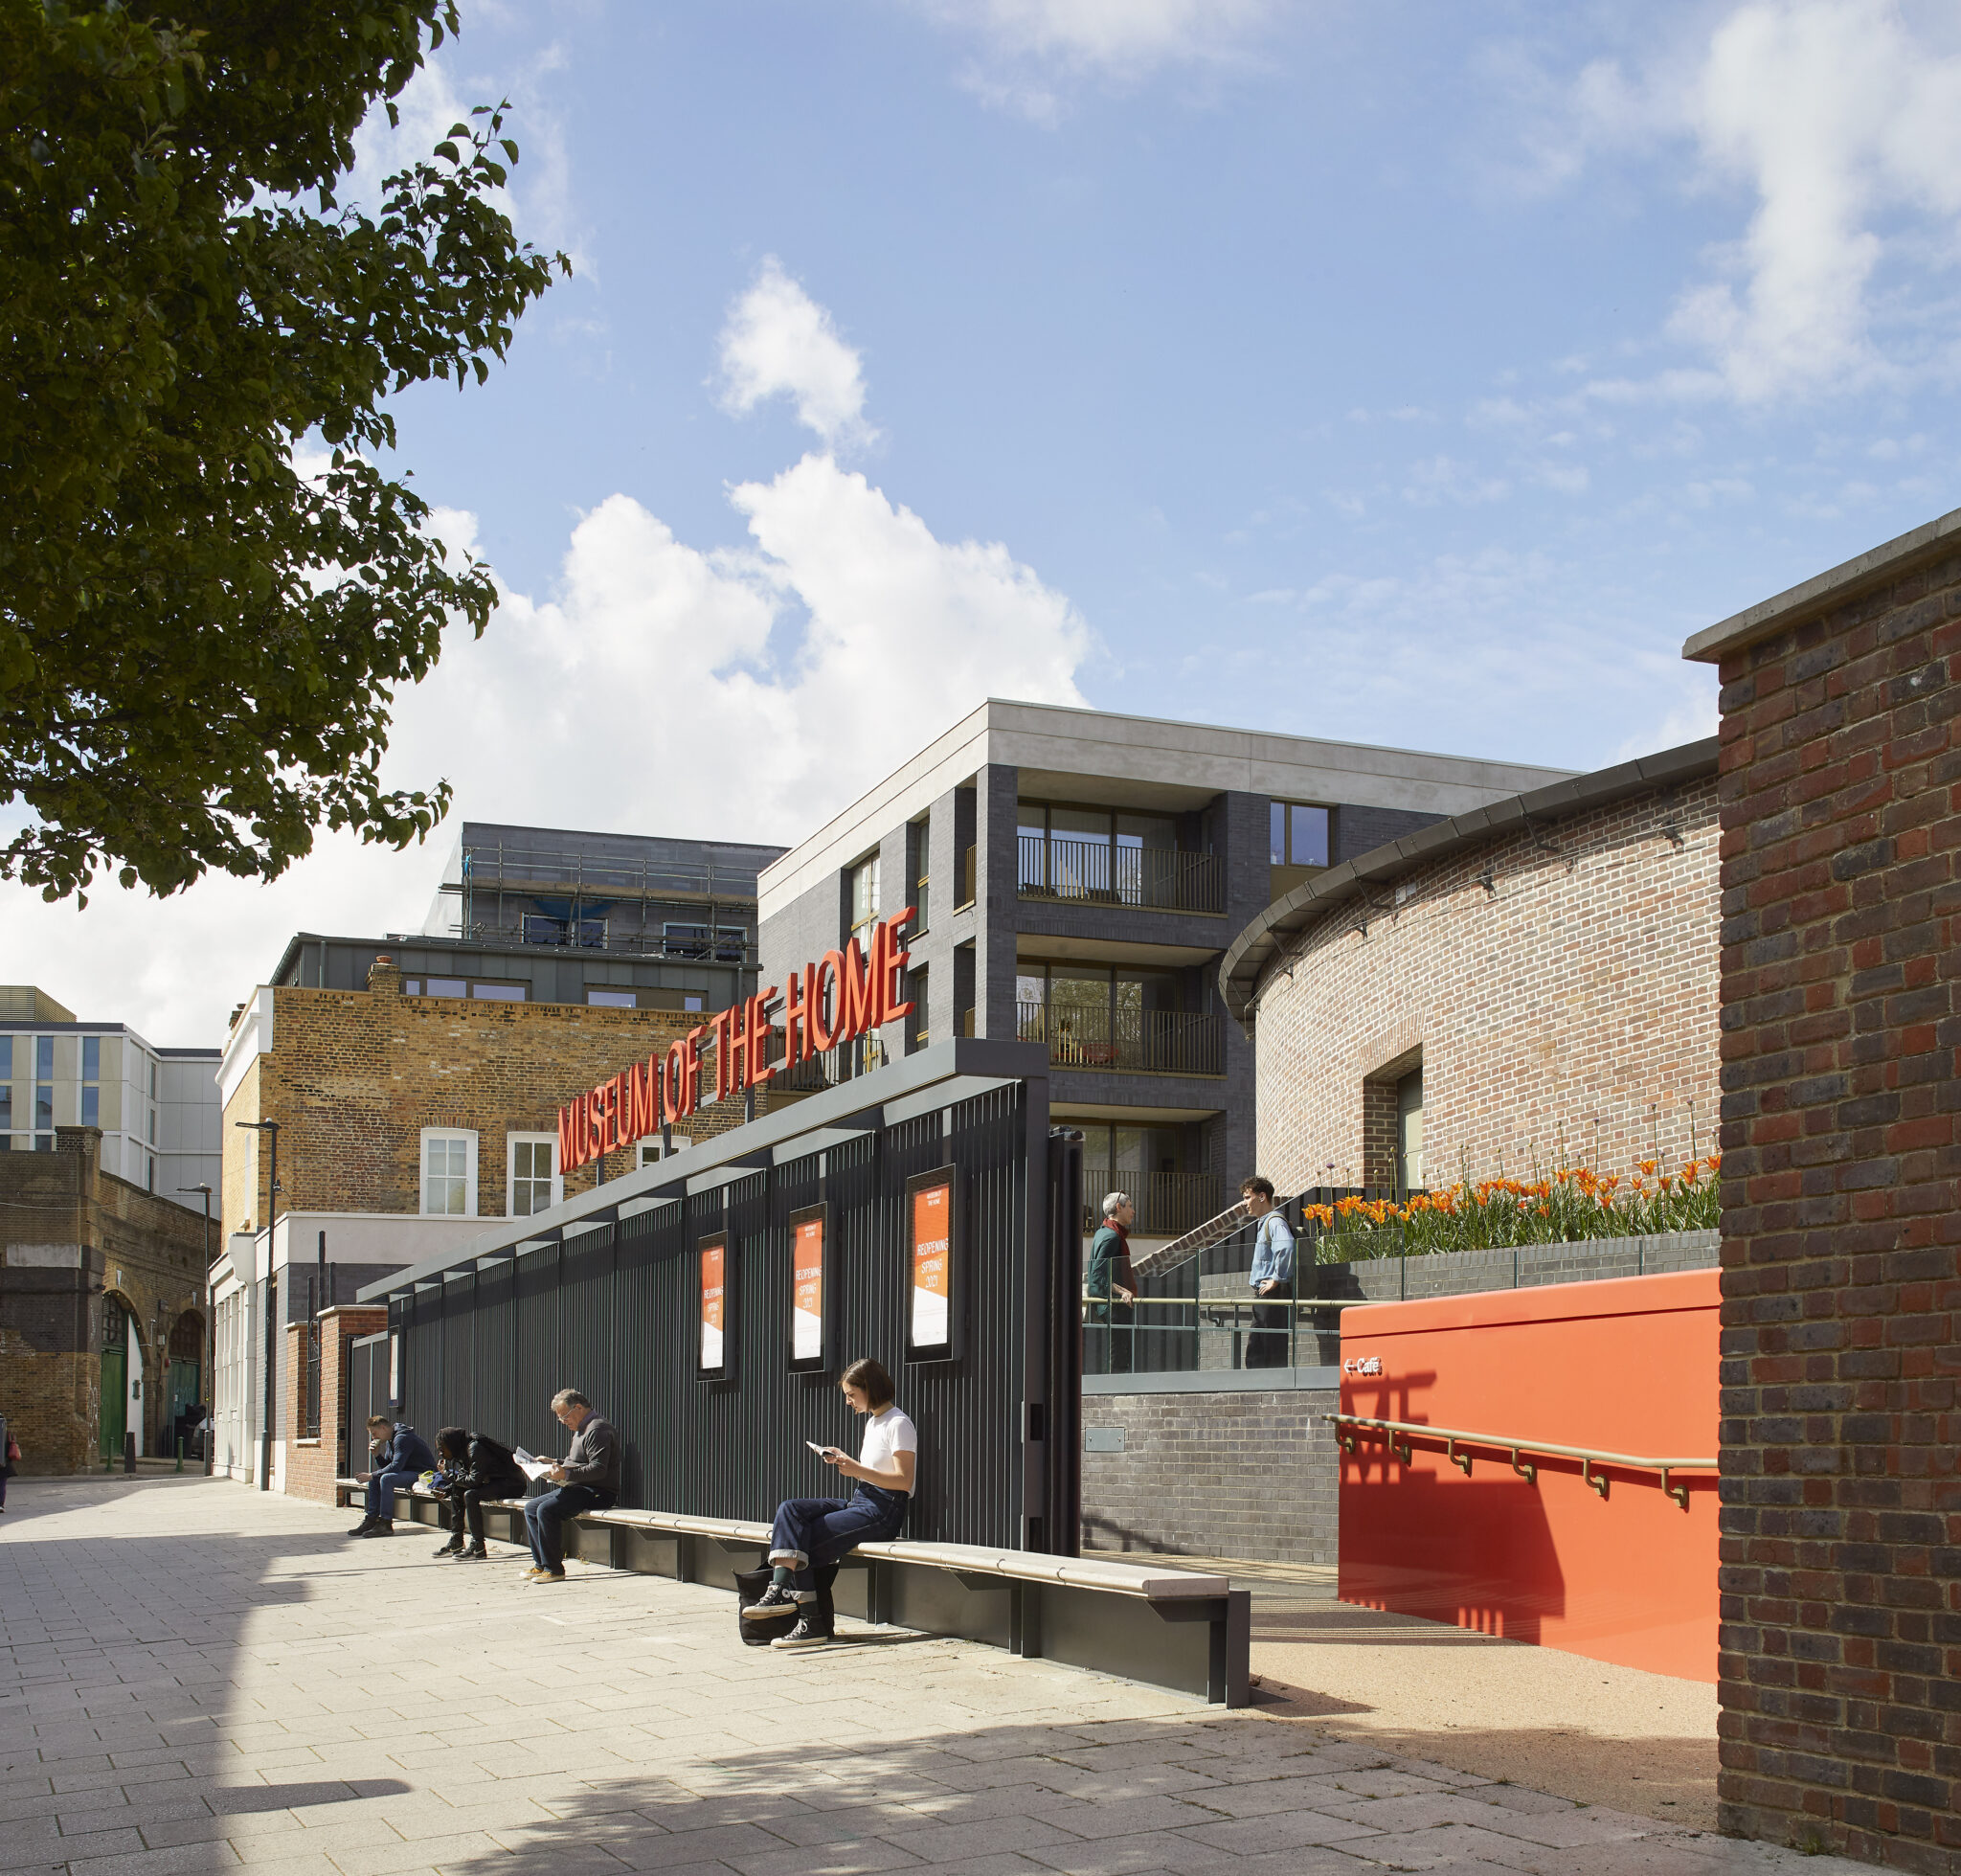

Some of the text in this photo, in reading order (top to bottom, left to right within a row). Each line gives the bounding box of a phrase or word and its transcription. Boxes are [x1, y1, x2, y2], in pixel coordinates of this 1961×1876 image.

[558, 906, 917, 1176] MUSEUM OF THE HOME
[916, 1237, 949, 1256] REOPENING
[921, 1258, 943, 1275] SPRING
[1357, 1356, 1380, 1373] Café
